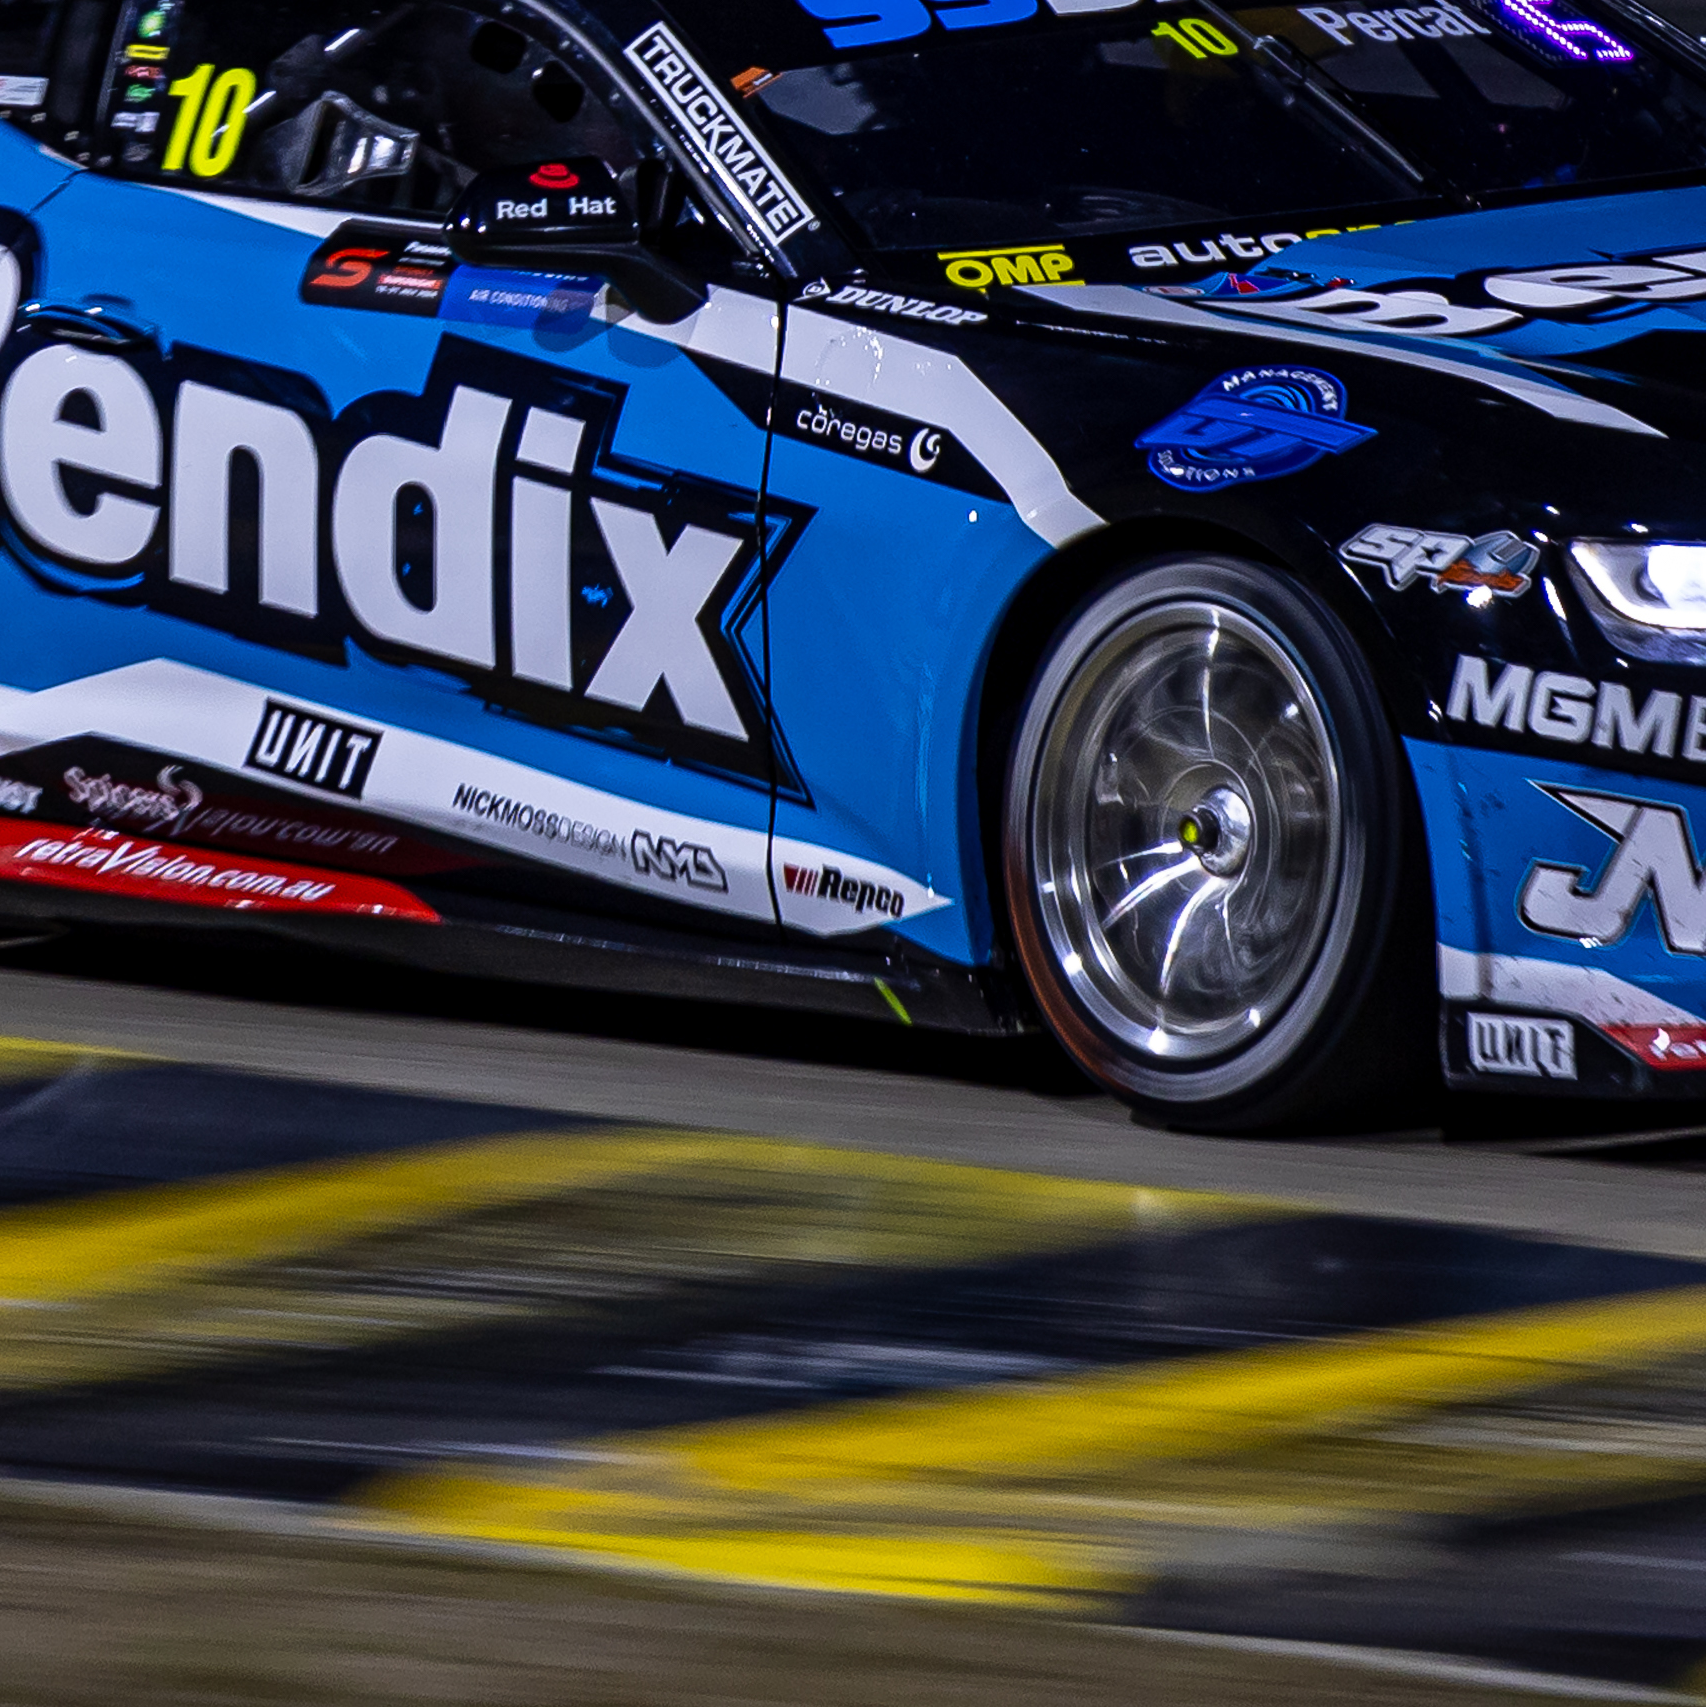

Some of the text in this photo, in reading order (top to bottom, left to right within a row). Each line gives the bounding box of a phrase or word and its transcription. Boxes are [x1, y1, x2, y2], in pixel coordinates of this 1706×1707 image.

[1151, 18, 1240, 59] 10
[161, 63, 257, 178] 10
[641, 34, 800, 235] TRUCKMATE
[496, 195, 618, 221] Red Hat
[945, 252, 1074, 288] OMP
[825, 284, 989, 327] DUNLOP
[796, 407, 904, 456] coregas
[254, 701, 375, 787] UNIT
[817, 864, 905, 918] Repco
